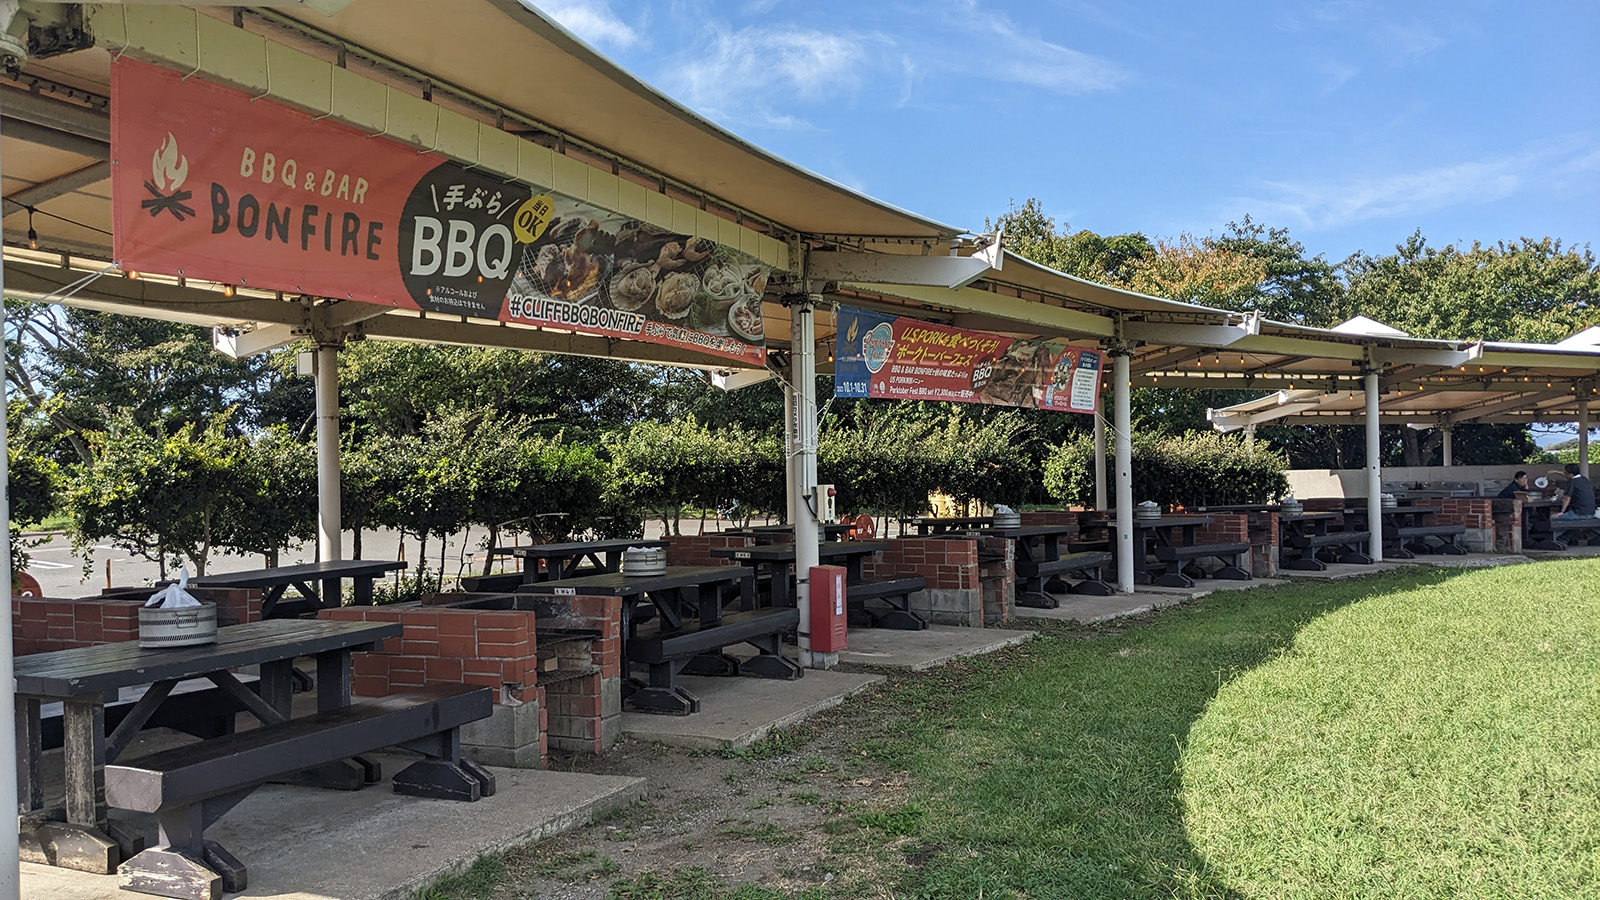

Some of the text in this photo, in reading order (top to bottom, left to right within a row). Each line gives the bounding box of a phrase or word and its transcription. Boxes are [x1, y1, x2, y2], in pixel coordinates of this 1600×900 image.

[240, 147, 369, 204] BBQ & BAR
[443, 184, 502, 214] 手ぶら
[211, 182, 384, 261] BONFIRE
[518, 210, 544, 237] OK
[409, 216, 513, 280] BBQ
[509, 294, 645, 334] #CLIFFBBQBONFIRE
[972, 366, 992, 382] BBQ
